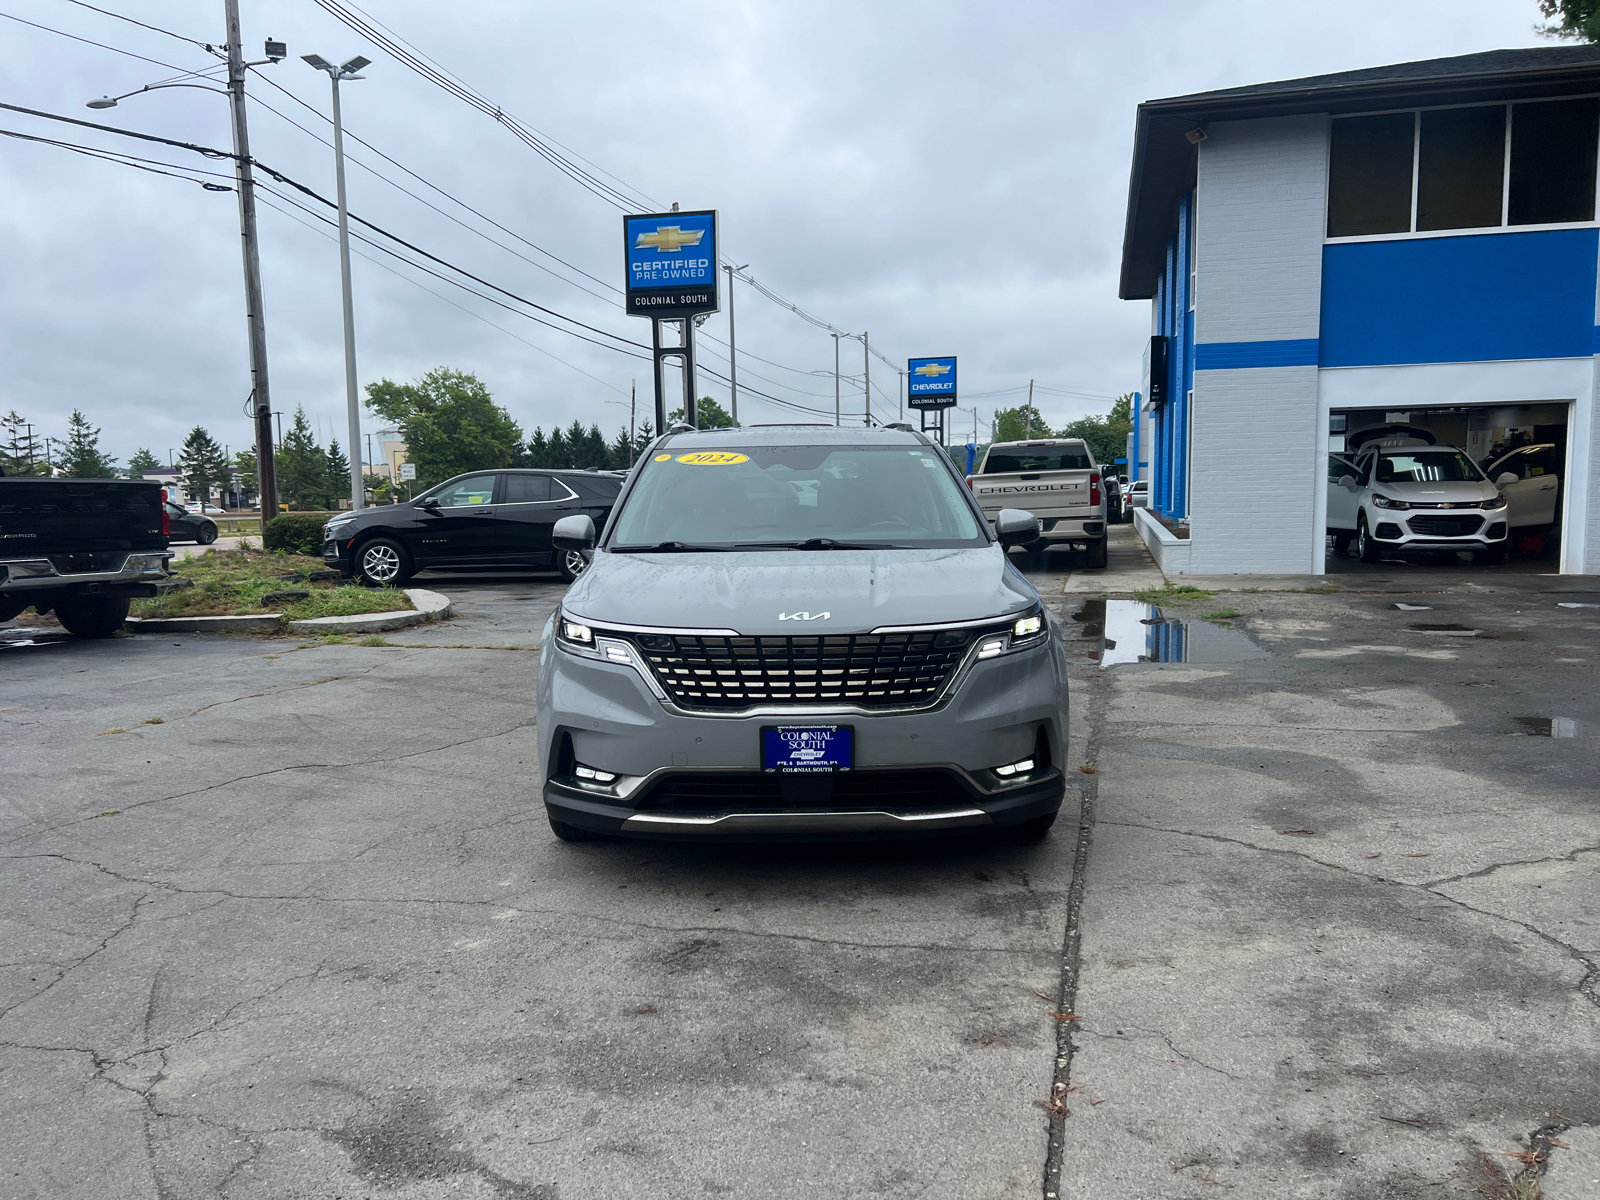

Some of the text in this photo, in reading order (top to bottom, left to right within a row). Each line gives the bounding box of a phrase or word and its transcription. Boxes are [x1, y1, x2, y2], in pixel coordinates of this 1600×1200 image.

[632, 259, 709, 271] CERTIFIED
[636, 268, 705, 280] PRE-OWNED
[635, 294, 708, 305] COLONIAL SOUTH
[685, 454, 739, 463] 2024
[980, 483, 1081, 494] CHEVROLET
[781, 731, 834, 740] COLONIAL
[789, 740, 826, 749] SOUTH
